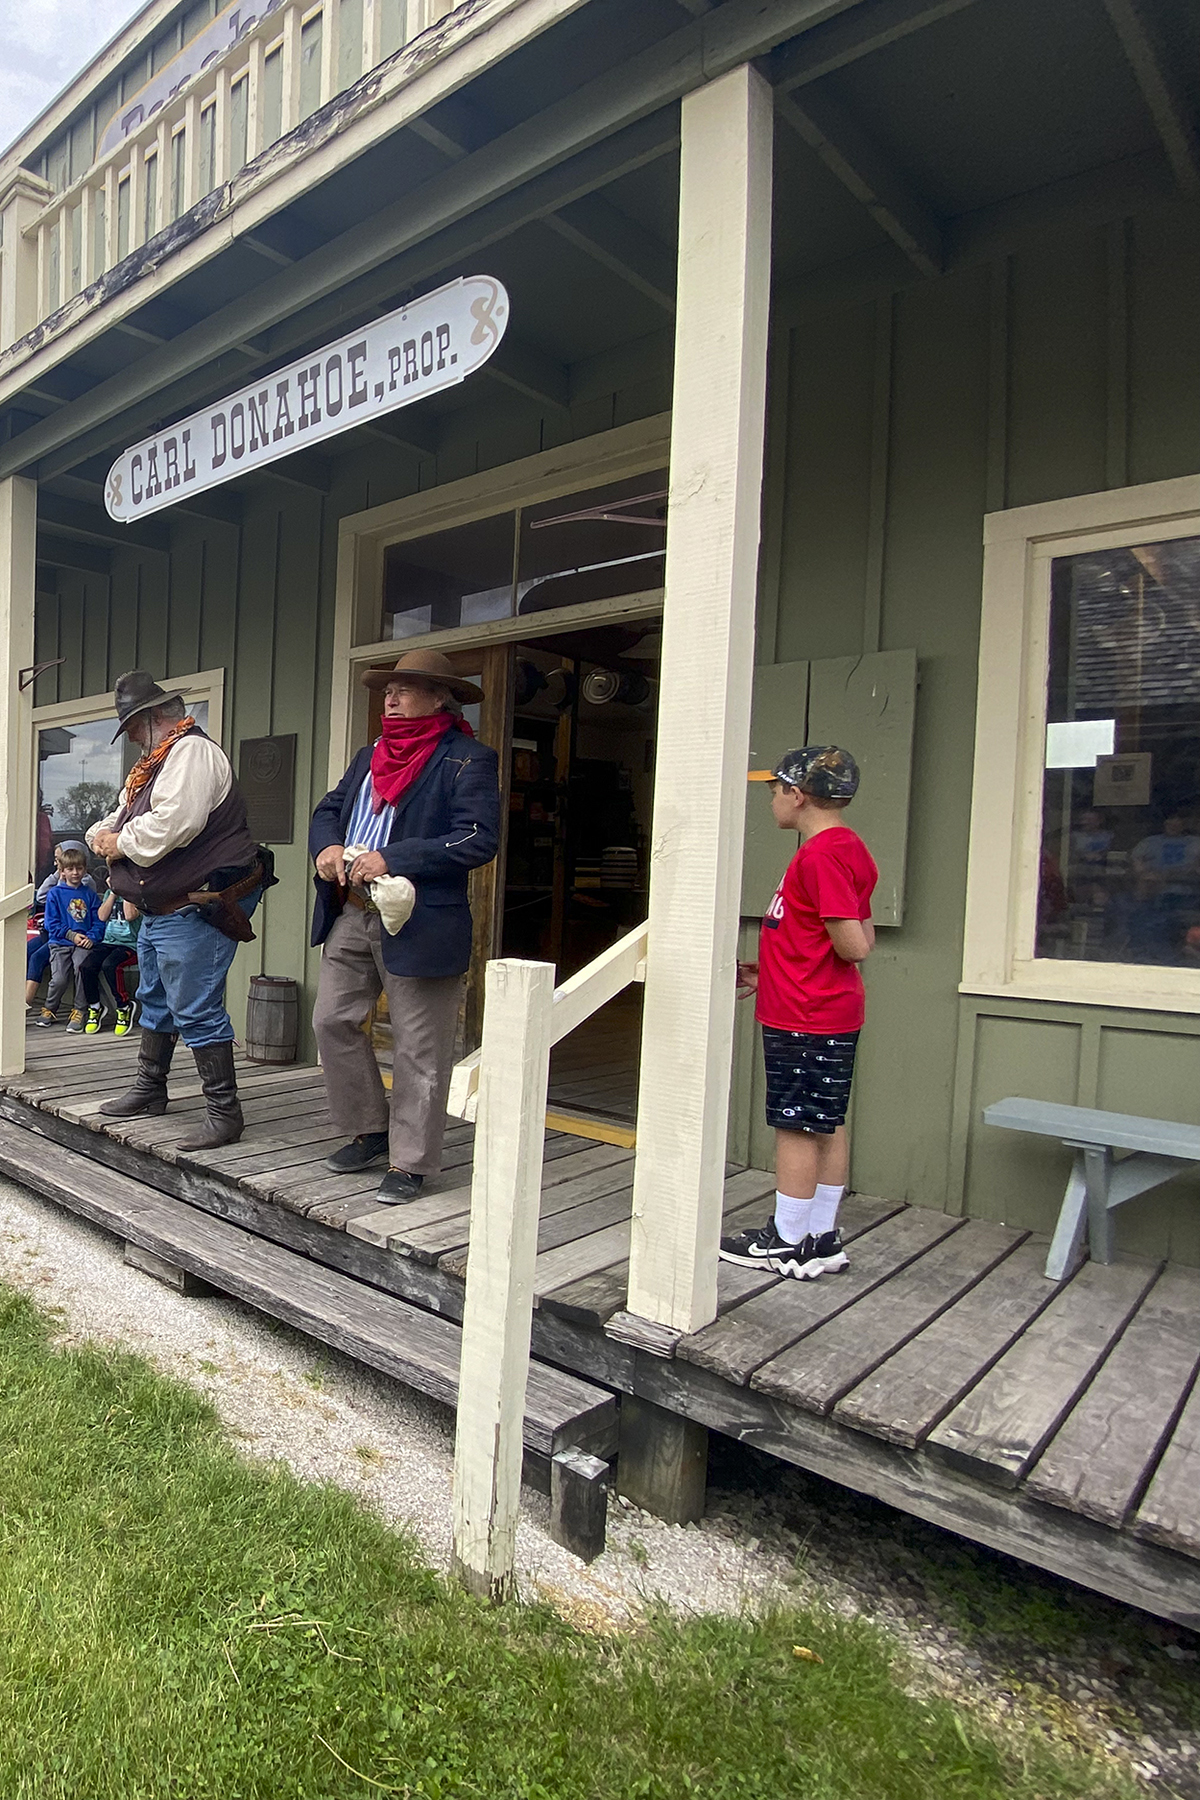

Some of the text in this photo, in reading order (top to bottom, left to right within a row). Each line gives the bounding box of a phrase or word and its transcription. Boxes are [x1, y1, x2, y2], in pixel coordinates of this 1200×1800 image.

[131, 322, 459, 506] CARL DONAHOE, PROP.
